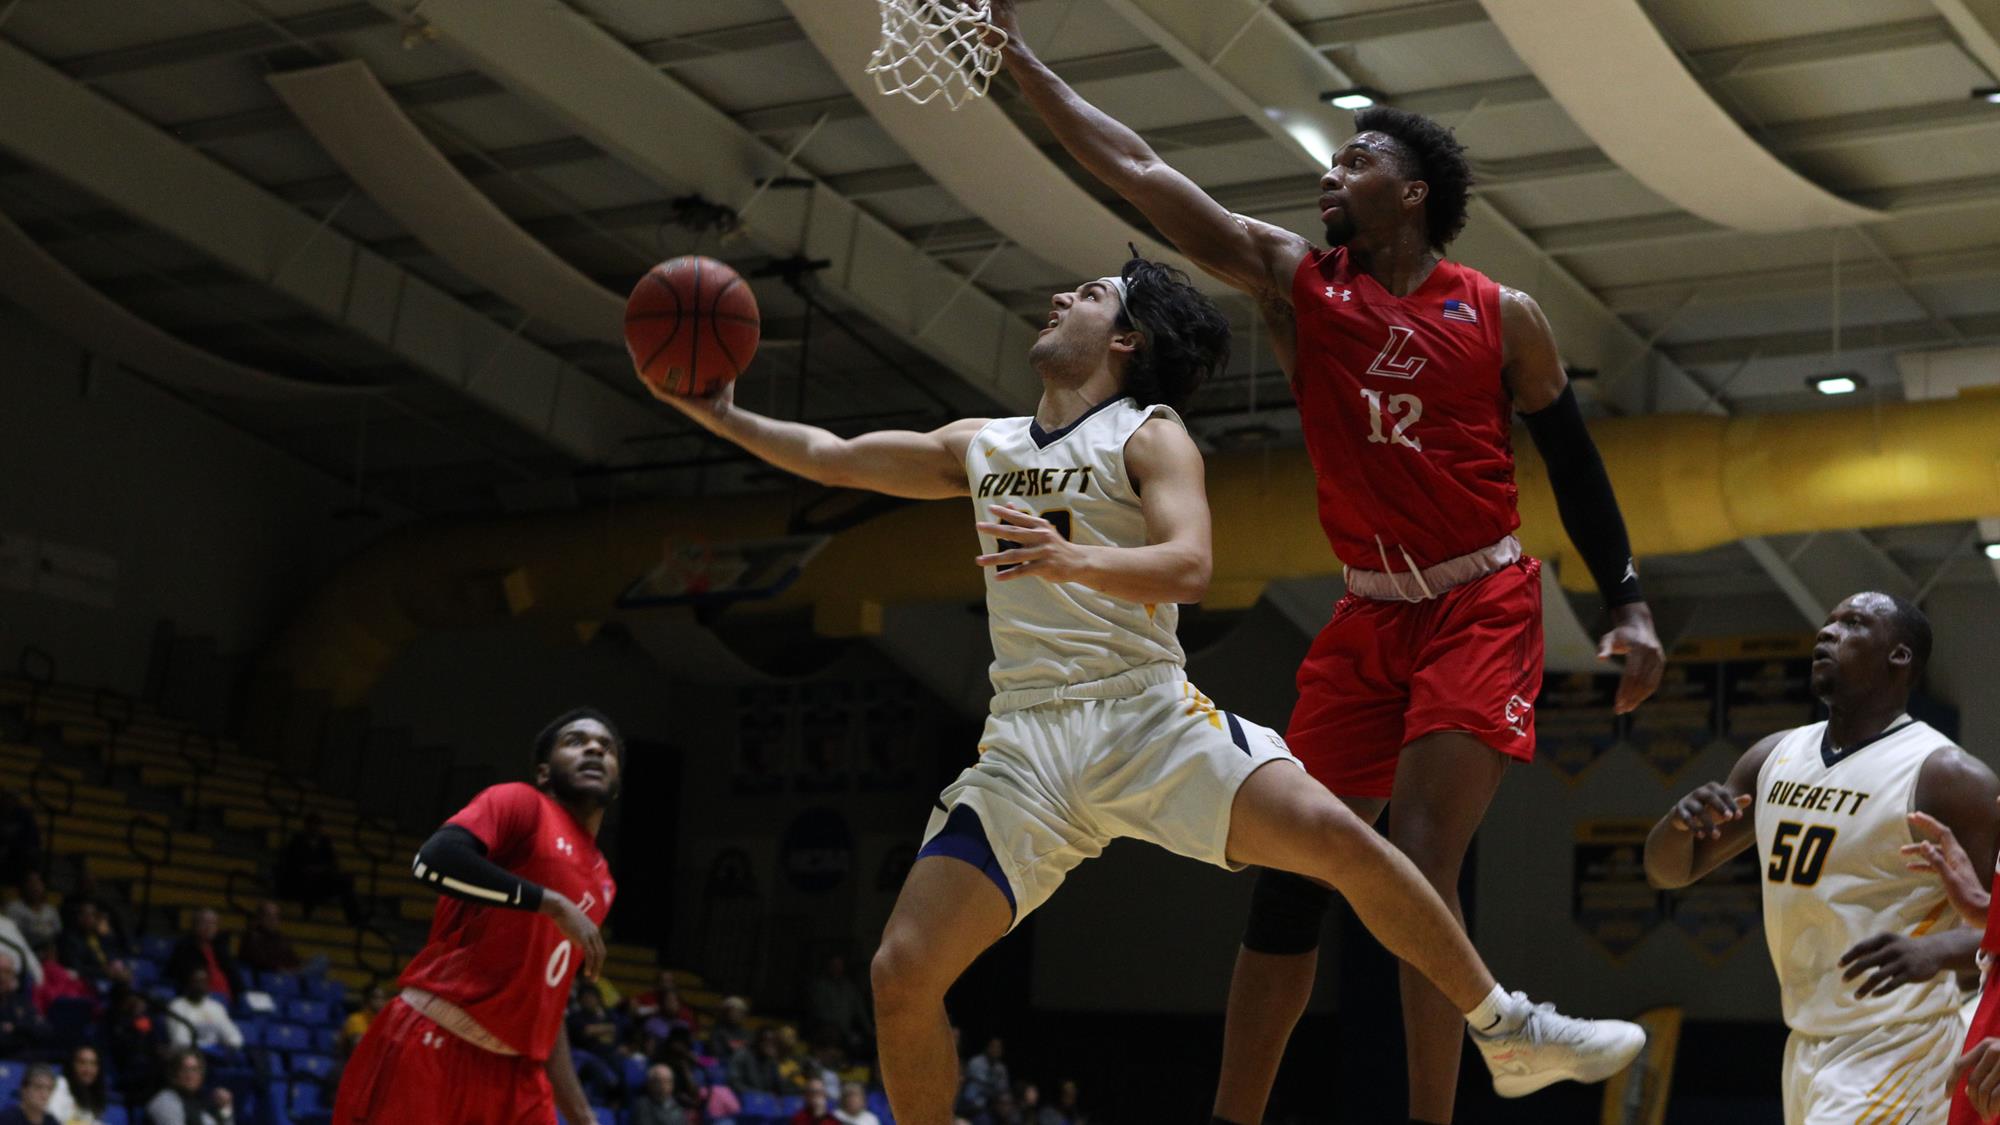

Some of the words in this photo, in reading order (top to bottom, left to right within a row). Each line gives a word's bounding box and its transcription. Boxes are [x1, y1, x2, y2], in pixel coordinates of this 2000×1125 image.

[1366, 325, 1428, 380] L
[1360, 388, 1423, 452] 12
[978, 466, 1092, 498] AVERETT
[1767, 781, 1870, 815] AVERETT
[1768, 821, 1837, 885] 50
[545, 939, 572, 988] 0
